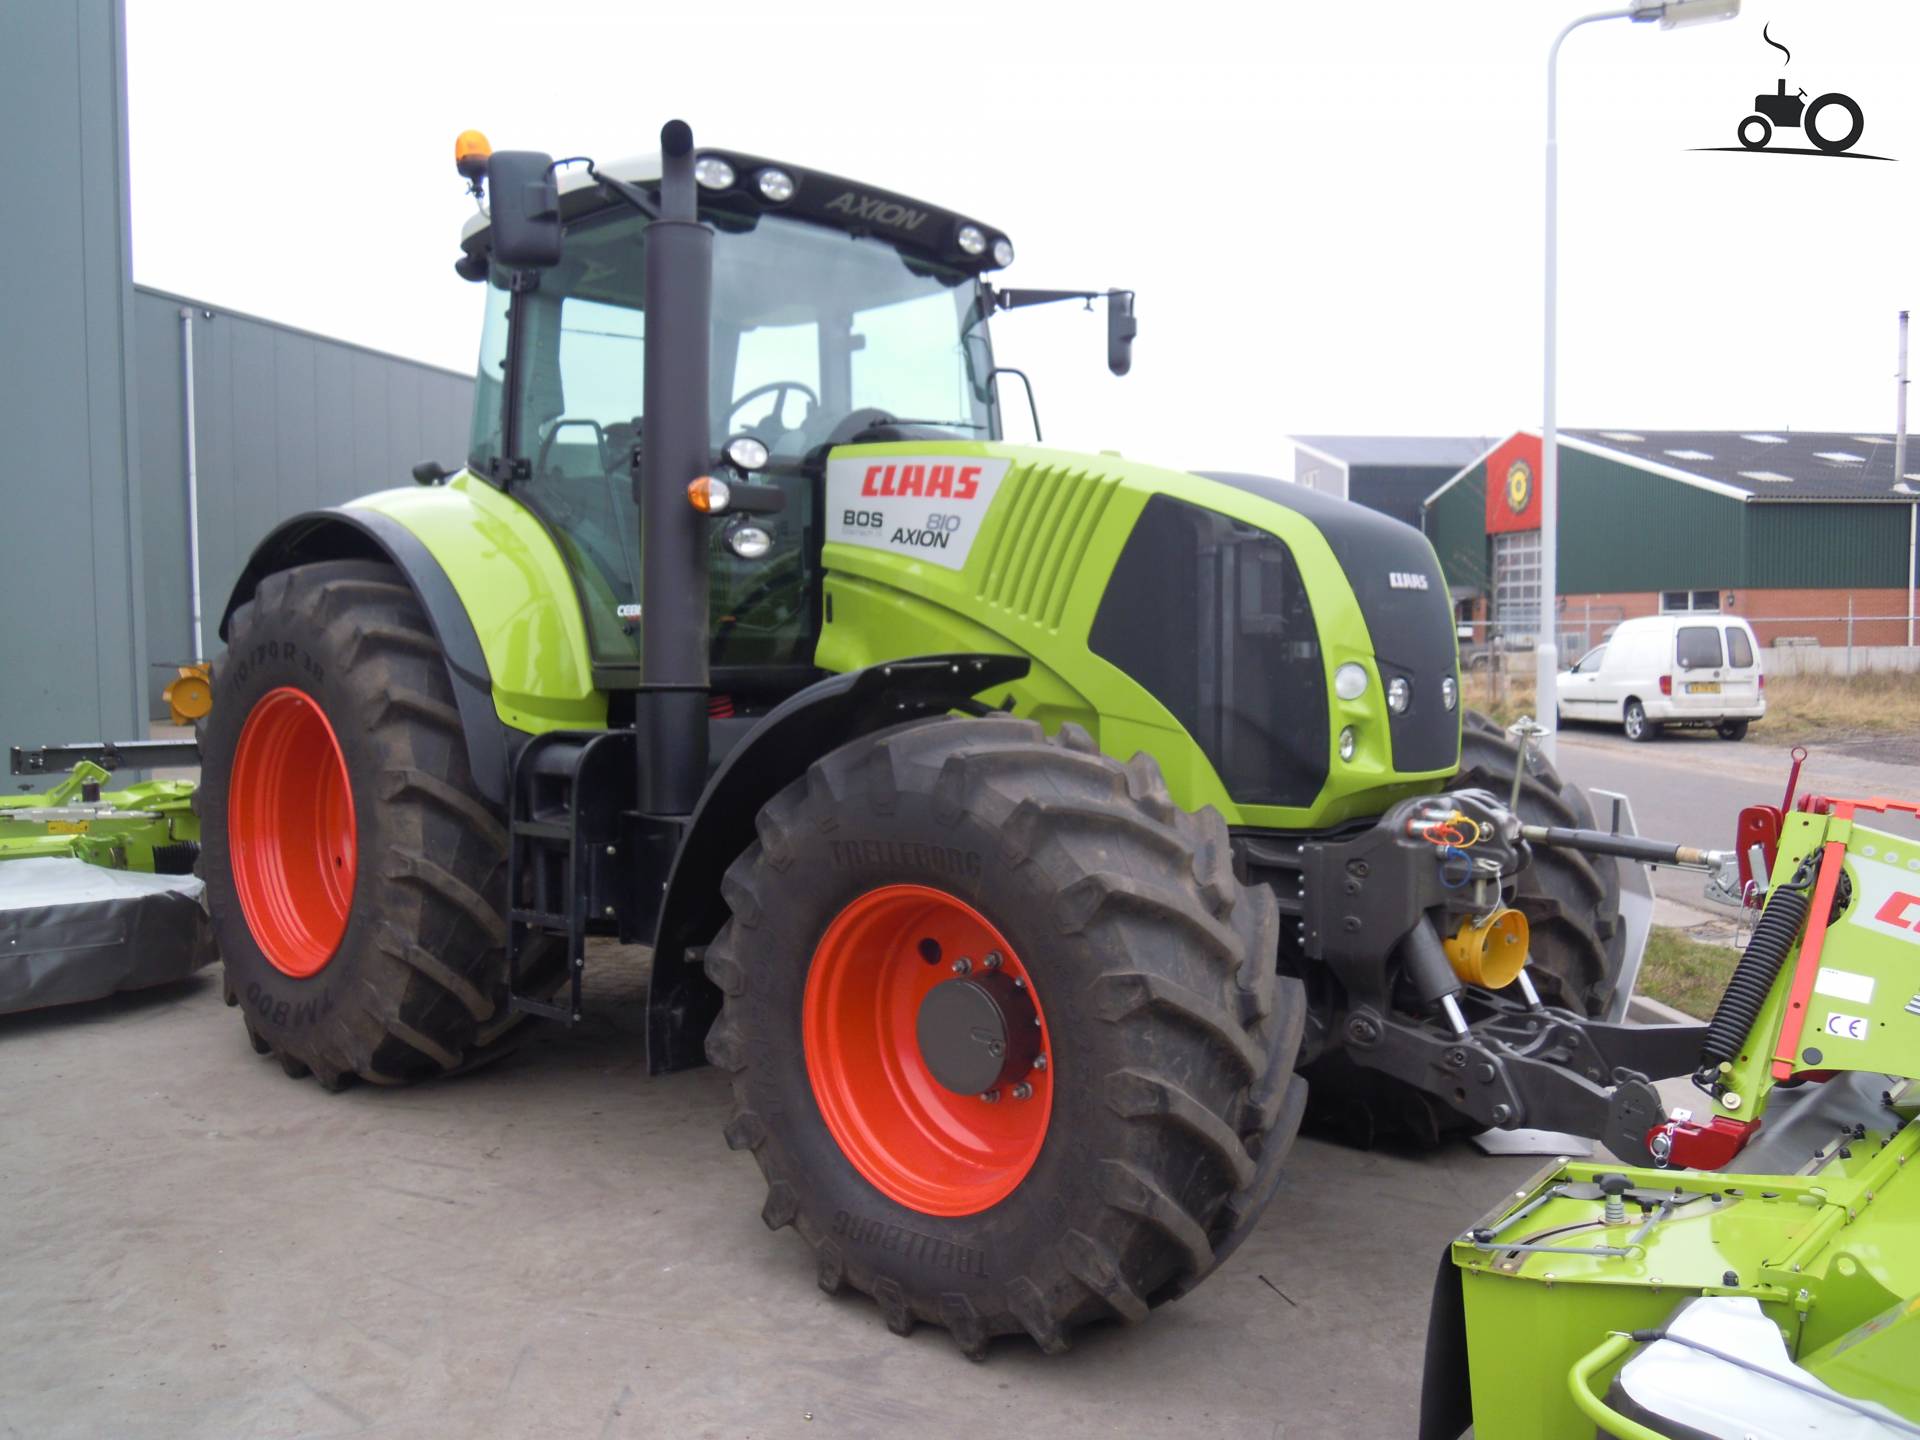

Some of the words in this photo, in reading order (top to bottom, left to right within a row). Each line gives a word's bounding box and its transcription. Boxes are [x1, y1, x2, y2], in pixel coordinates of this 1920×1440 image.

[826, 192, 929, 230] AXION
[861, 464, 982, 500] CLAAS
[843, 509, 883, 528] BOS
[926, 512, 961, 531] 810
[890, 527, 950, 549] AXION
[1389, 571, 1428, 590] CLAAS
[1829, 1015, 1861, 1038] CE
